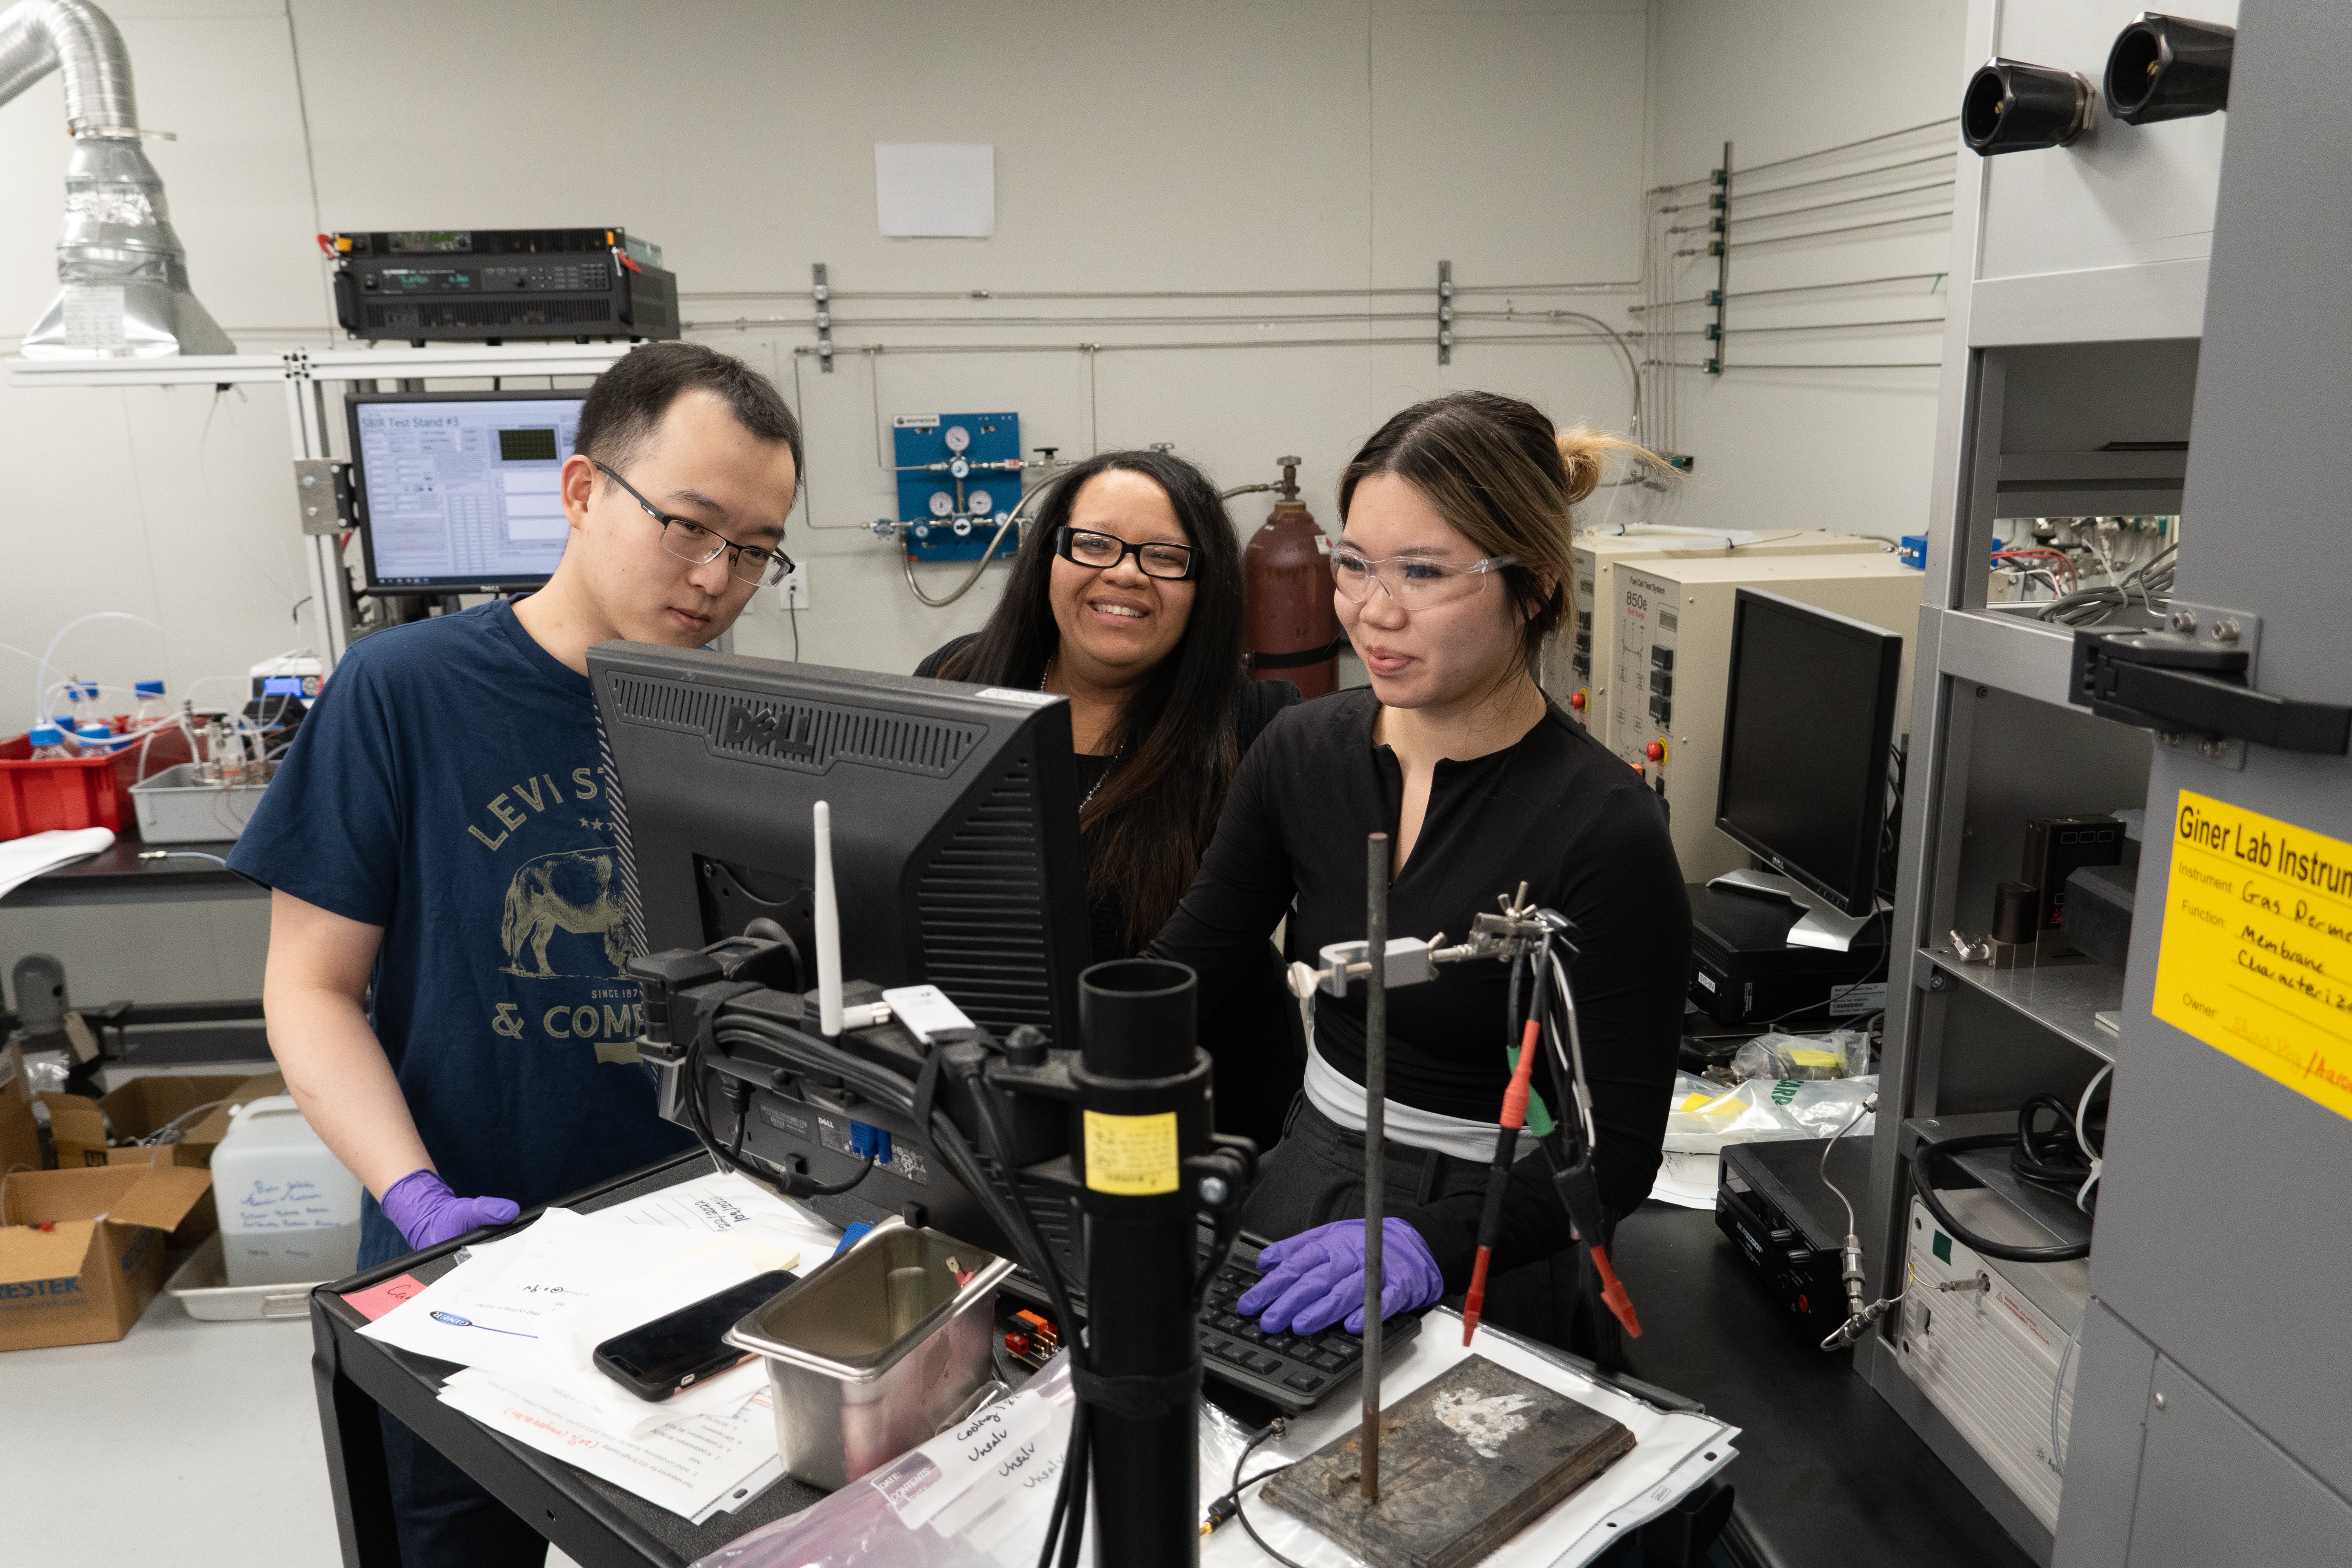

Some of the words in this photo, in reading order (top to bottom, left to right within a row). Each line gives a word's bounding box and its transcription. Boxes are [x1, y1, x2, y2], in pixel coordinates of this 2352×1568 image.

[387, 417, 410, 427] Test
[413, 416, 443, 427] Stand
[445, 416, 459, 427] #3
[1627, 591, 1647, 611] 850e
[726, 705, 815, 757] DELL
[468, 774, 563, 851] LEVI
[572, 767, 608, 799] S
[2179, 805, 2230, 851] Giner
[2235, 823, 2272, 868] Lab
[2242, 881, 2280, 914] Gas
[2241, 925, 2324, 974] Membrane
[591, 990, 619, 999] SINCE
[492, 1003, 525, 1039] &
[818, 1117, 834, 1128] DELL
[0, 1277, 82, 1299] ESTEK
[433, 1312, 469, 1326] GINER
[602, 1444, 621, 1457] loading
[621, 1451, 633, 1463] high
[675, 1462, 691, 1472] Initial
[688, 1456, 702, 1465] hold
[660, 1468, 683, 1484] sequence
[682, 1478, 694, 1489] Test
[878, 1471, 901, 1490] DATE:
[890, 1467, 932, 1503] CONTENTS:
